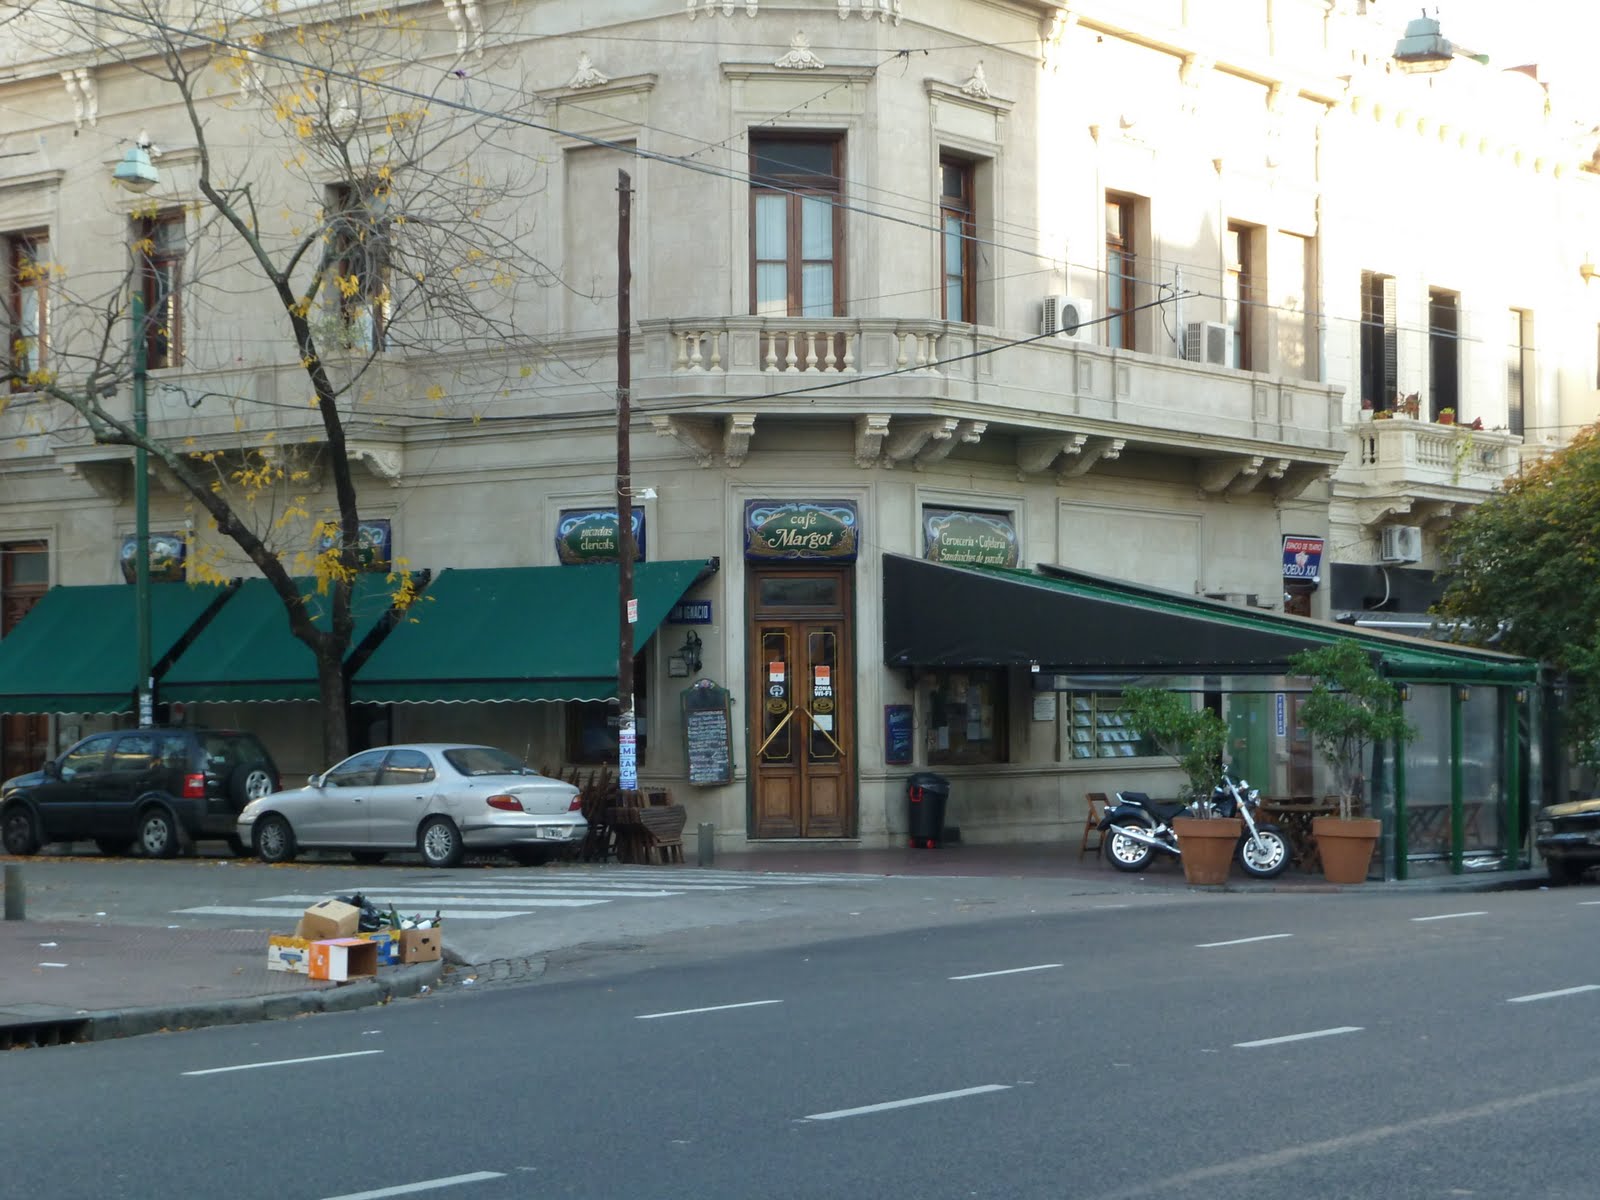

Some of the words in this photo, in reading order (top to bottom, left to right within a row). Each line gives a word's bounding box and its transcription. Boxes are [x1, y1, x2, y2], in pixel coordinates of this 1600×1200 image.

[790, 512, 817, 530] café
[580, 526, 613, 540] picadas
[767, 528, 834, 549] Margot
[580, 538, 615, 550] clericots
